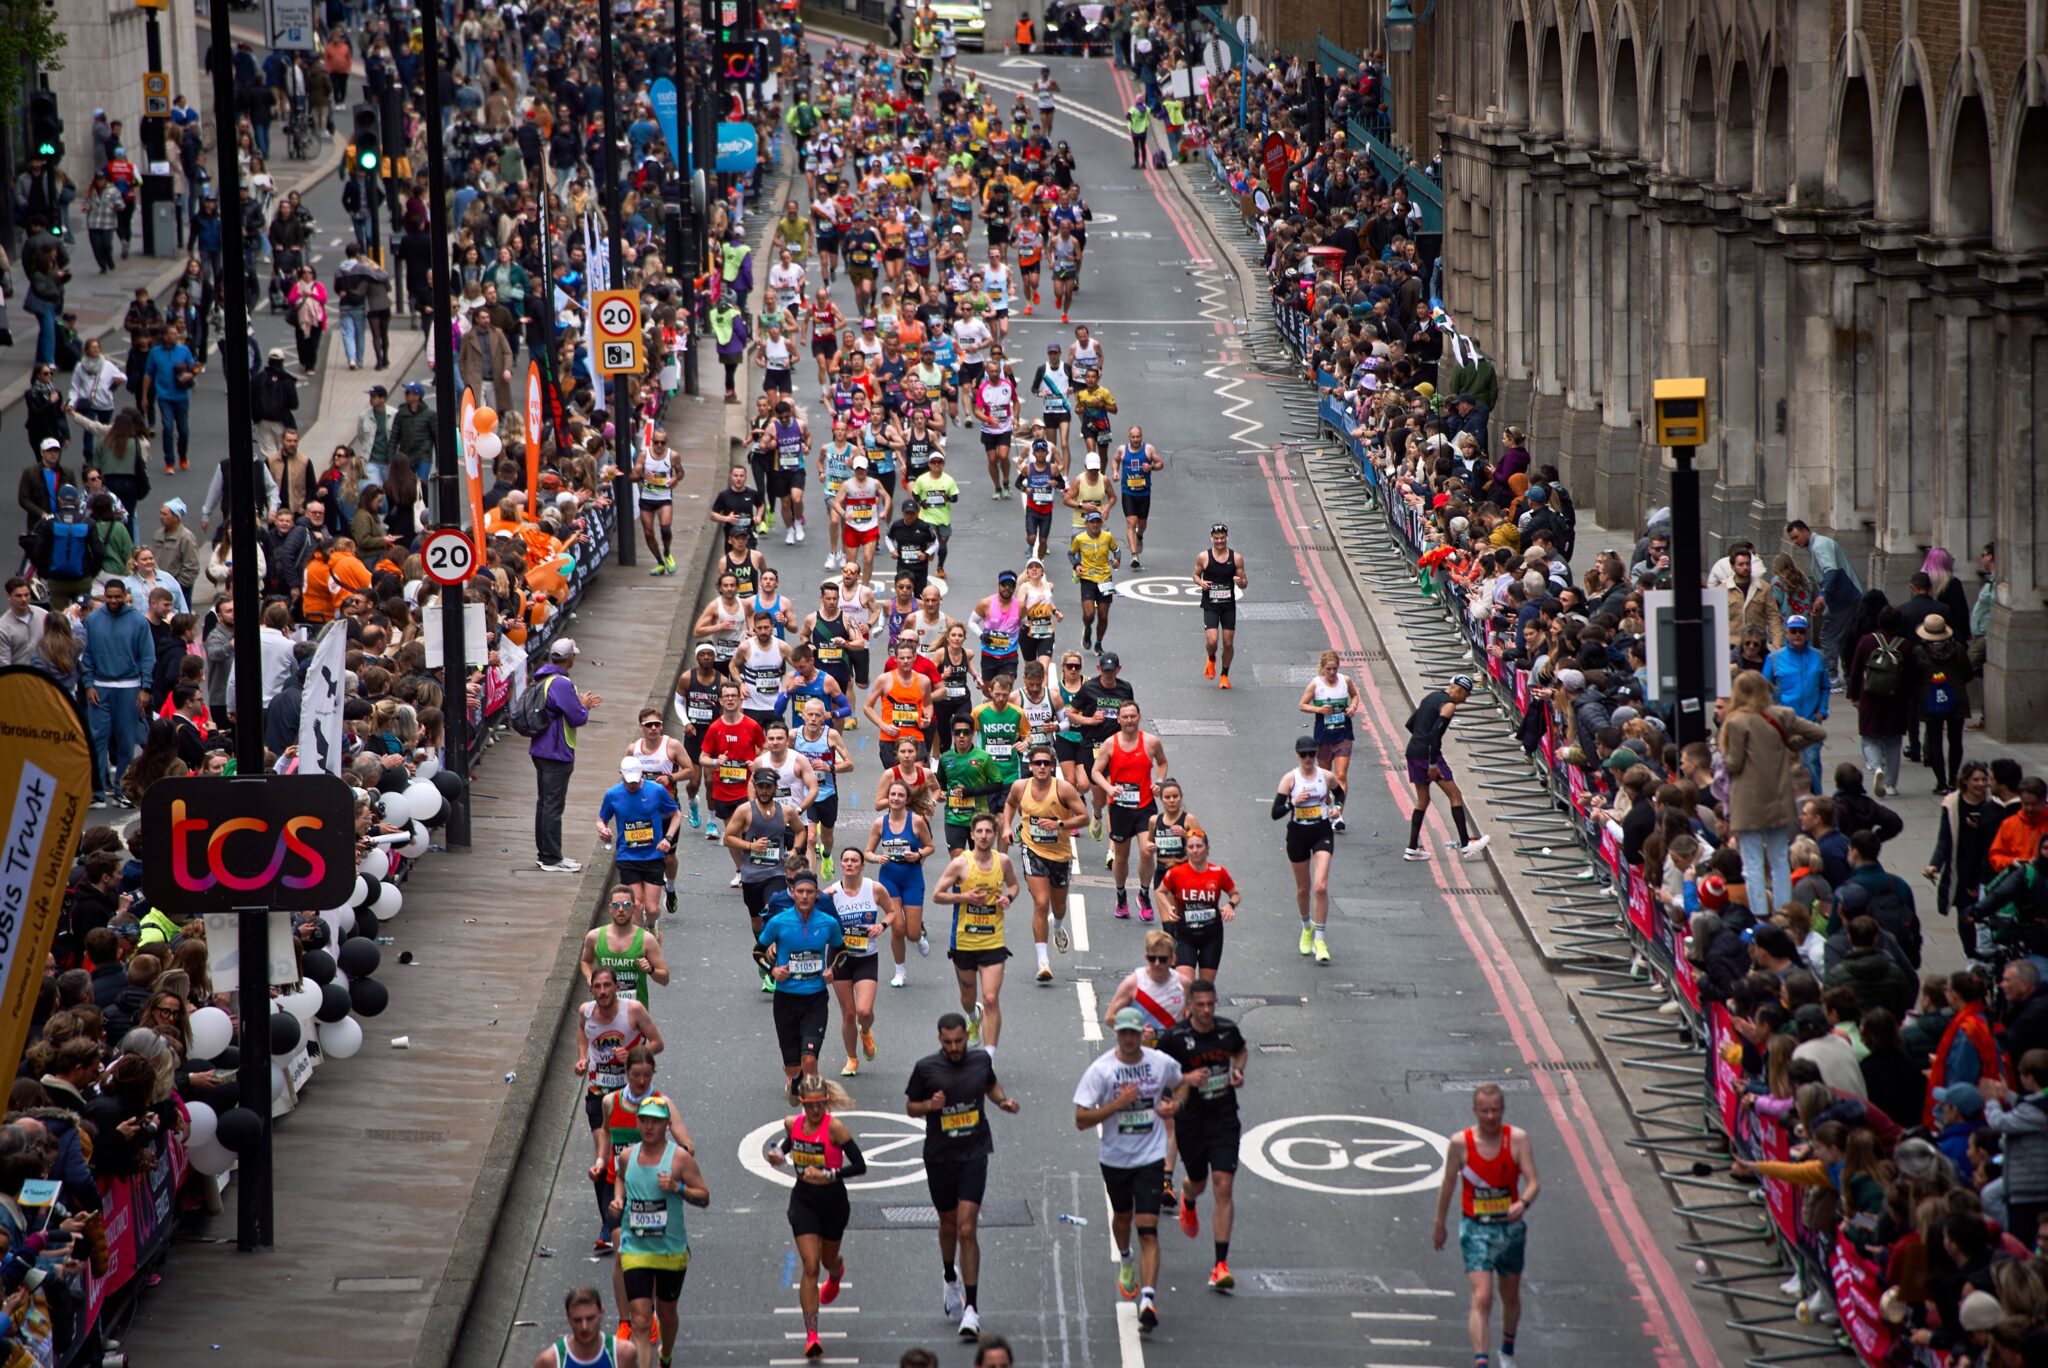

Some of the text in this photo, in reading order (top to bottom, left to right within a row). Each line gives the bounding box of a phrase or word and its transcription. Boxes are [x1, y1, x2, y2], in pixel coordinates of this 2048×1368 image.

[603, 308, 631, 326] 20
[431, 546, 469, 568] 20
[983, 723, 1016, 733] NSPCC
[726, 735, 738, 743] Tim
[6, 779, 45, 873] Trust
[625, 822, 636, 830] tcs
[43, 792, 80, 888] Unlimited
[171, 799, 326, 891] tcs
[1182, 888, 1215, 902] LEAH
[838, 901, 871, 914] CARYS
[840, 912, 862, 921] STBURY
[601, 956, 635, 968] STUART
[794, 962, 817, 971] 51051
[1114, 1064, 1152, 1082] VINNIE
[635, 1214, 662, 1225] 50332
